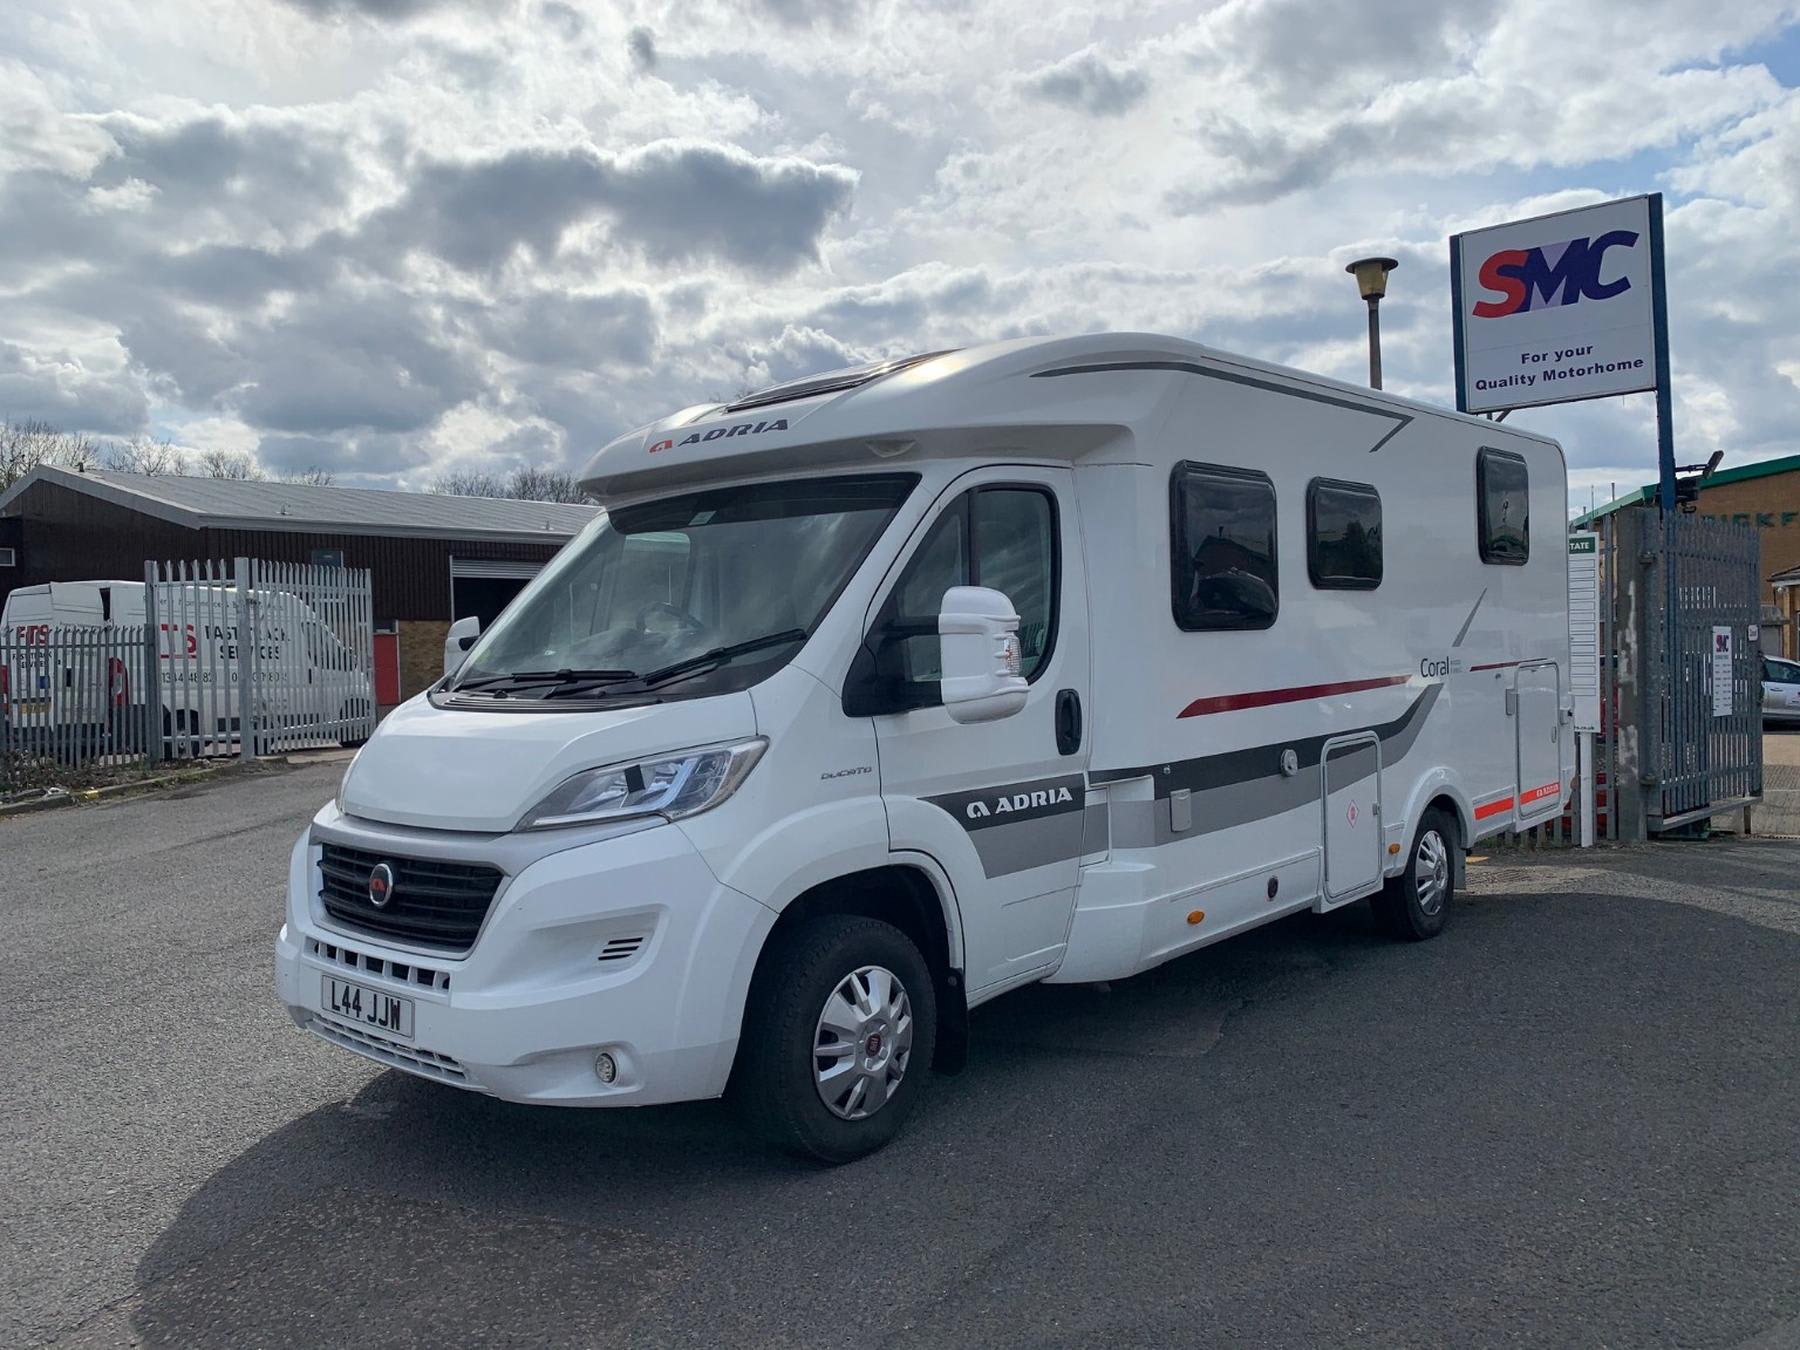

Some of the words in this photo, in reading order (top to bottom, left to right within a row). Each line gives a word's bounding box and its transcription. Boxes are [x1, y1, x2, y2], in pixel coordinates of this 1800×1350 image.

[1472, 230, 1640, 318] SMC
[1521, 352, 1549, 364] For
[1554, 345, 1594, 362] your
[1475, 373, 1537, 391] Quality
[1542, 358, 1644, 382] Motorhome
[677, 418, 788, 447] ADRIA
[1569, 542, 1590, 551] TATE
[1420, 655, 1450, 678] Coral
[995, 787, 1073, 814] ADRIA
[332, 980, 362, 1018] L44
[367, 993, 401, 1031] JJW
